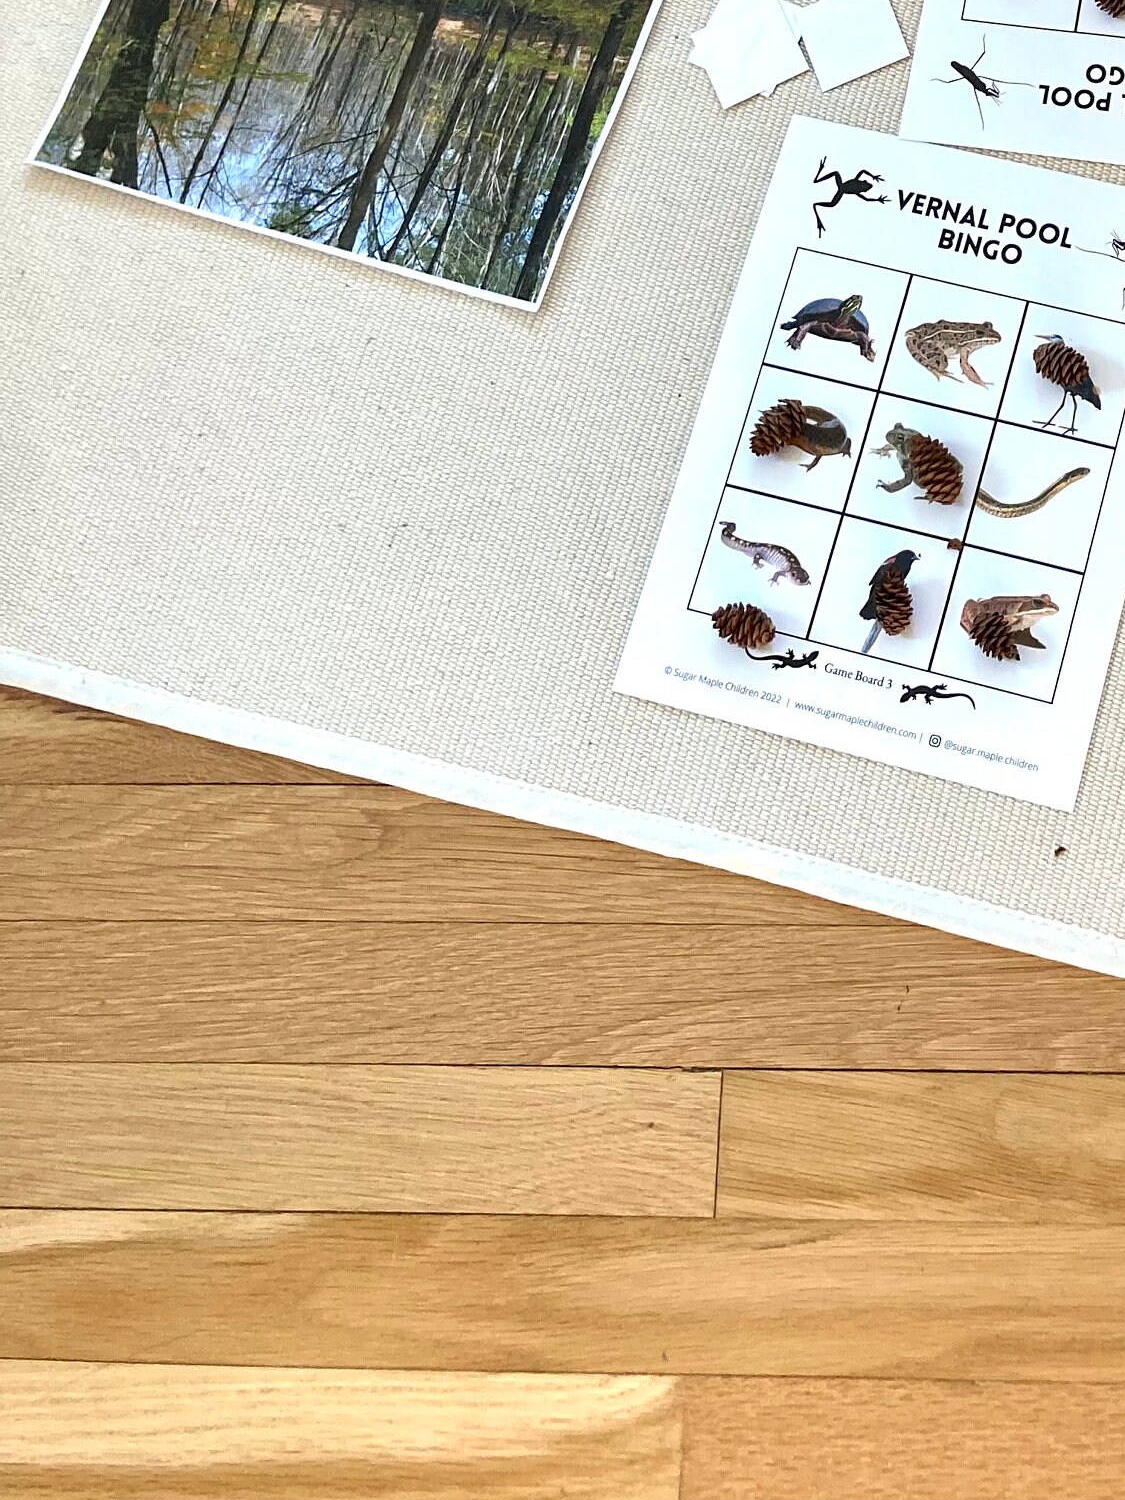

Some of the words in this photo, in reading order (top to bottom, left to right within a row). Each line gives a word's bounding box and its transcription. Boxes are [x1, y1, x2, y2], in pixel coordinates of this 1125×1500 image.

[1039, 84, 1112, 112] POOL
[898, 189, 990, 231] VERNAL
[998, 213, 1072, 249] POOL
[937, 227, 1023, 265] BINGO
[824, 662, 853, 679] Game
[855, 668, 884, 688] Board
[885, 679, 893, 689] 3
[673, 668, 697, 681] Sugar
[698, 674, 724, 689] Maple
[725, 681, 759, 698] Children
[760, 691, 782, 704] 2022
[794, 700, 917, 740] www.sugarmaplechildren.com
